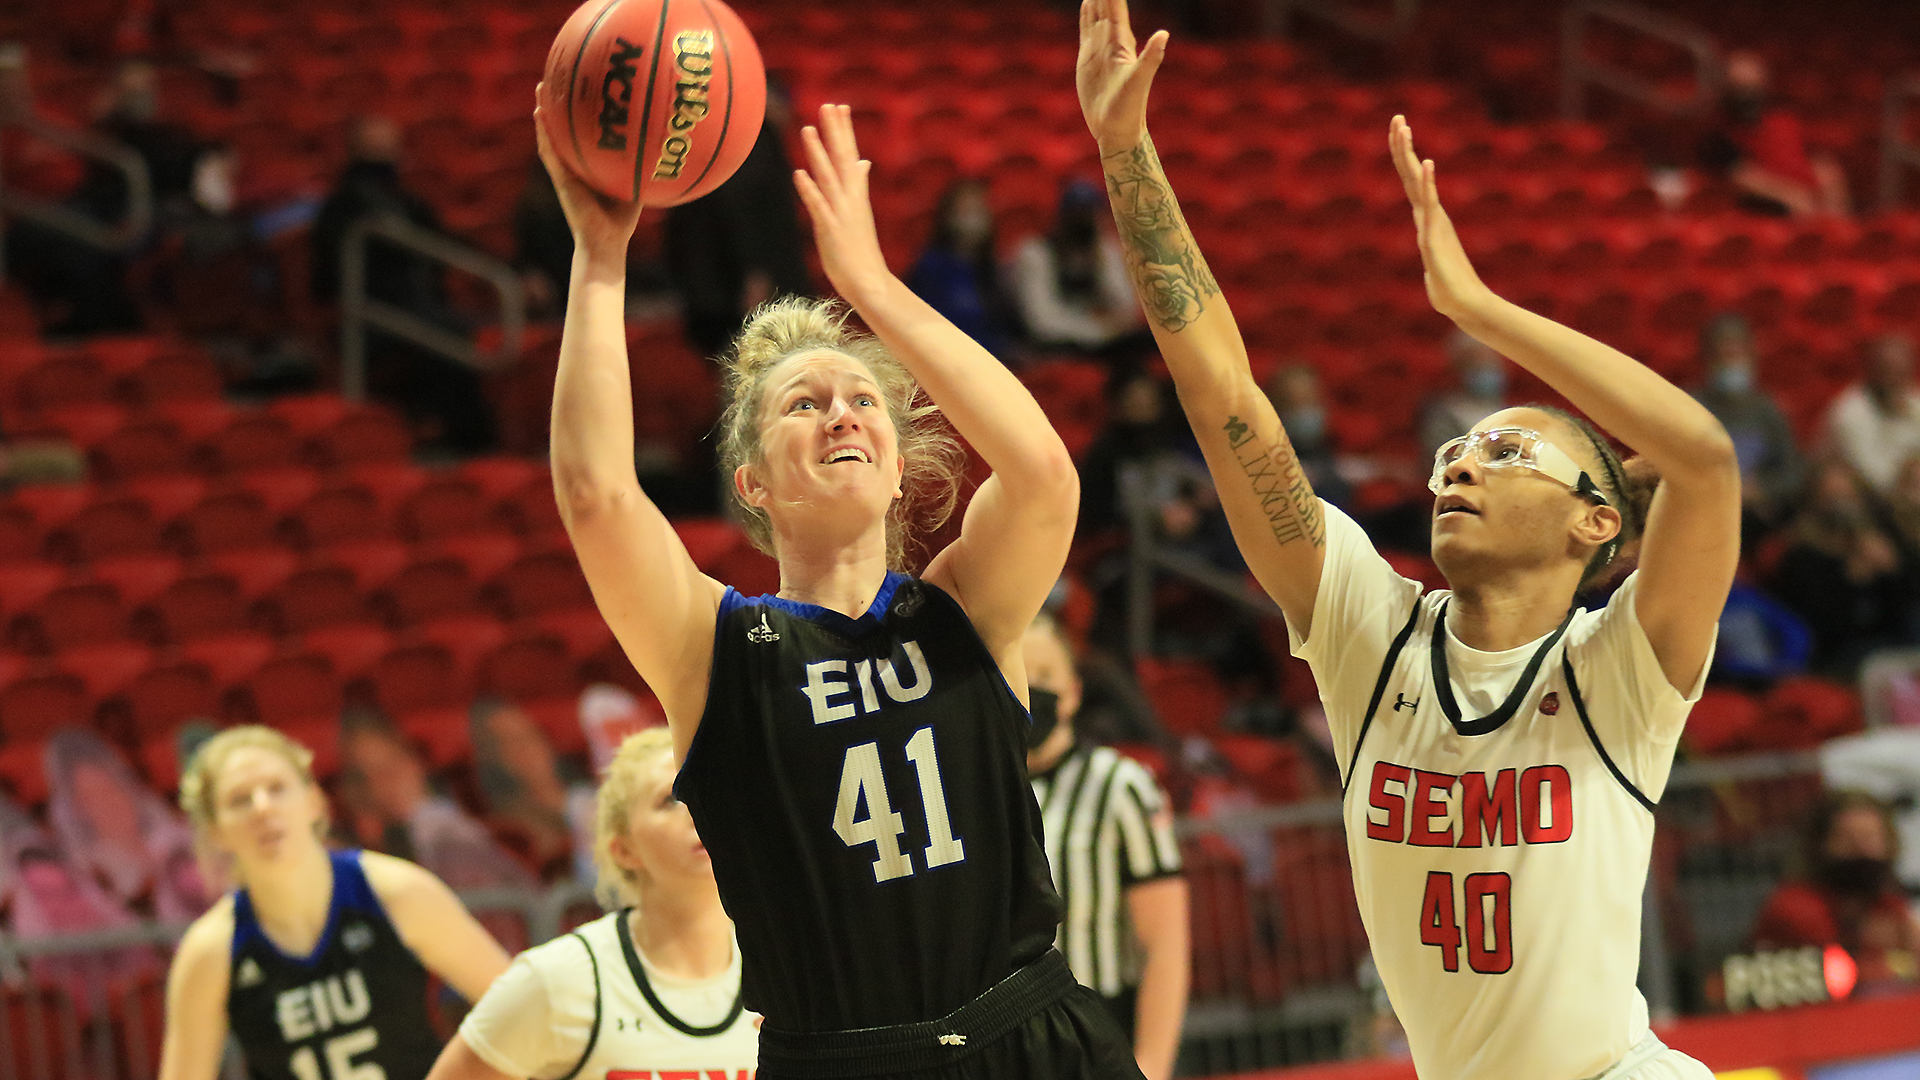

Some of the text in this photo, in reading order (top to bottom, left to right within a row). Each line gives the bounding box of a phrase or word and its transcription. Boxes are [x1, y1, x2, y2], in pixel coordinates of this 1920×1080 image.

[597, 37, 643, 150] NCAA
[652, 30, 714, 181] Wilson
[800, 640, 933, 725] EIU
[832, 726, 966, 884] 41
[1366, 760, 1573, 848] SEMO
[1419, 871, 1513, 975] 40
[275, 968, 371, 1043] EIU
